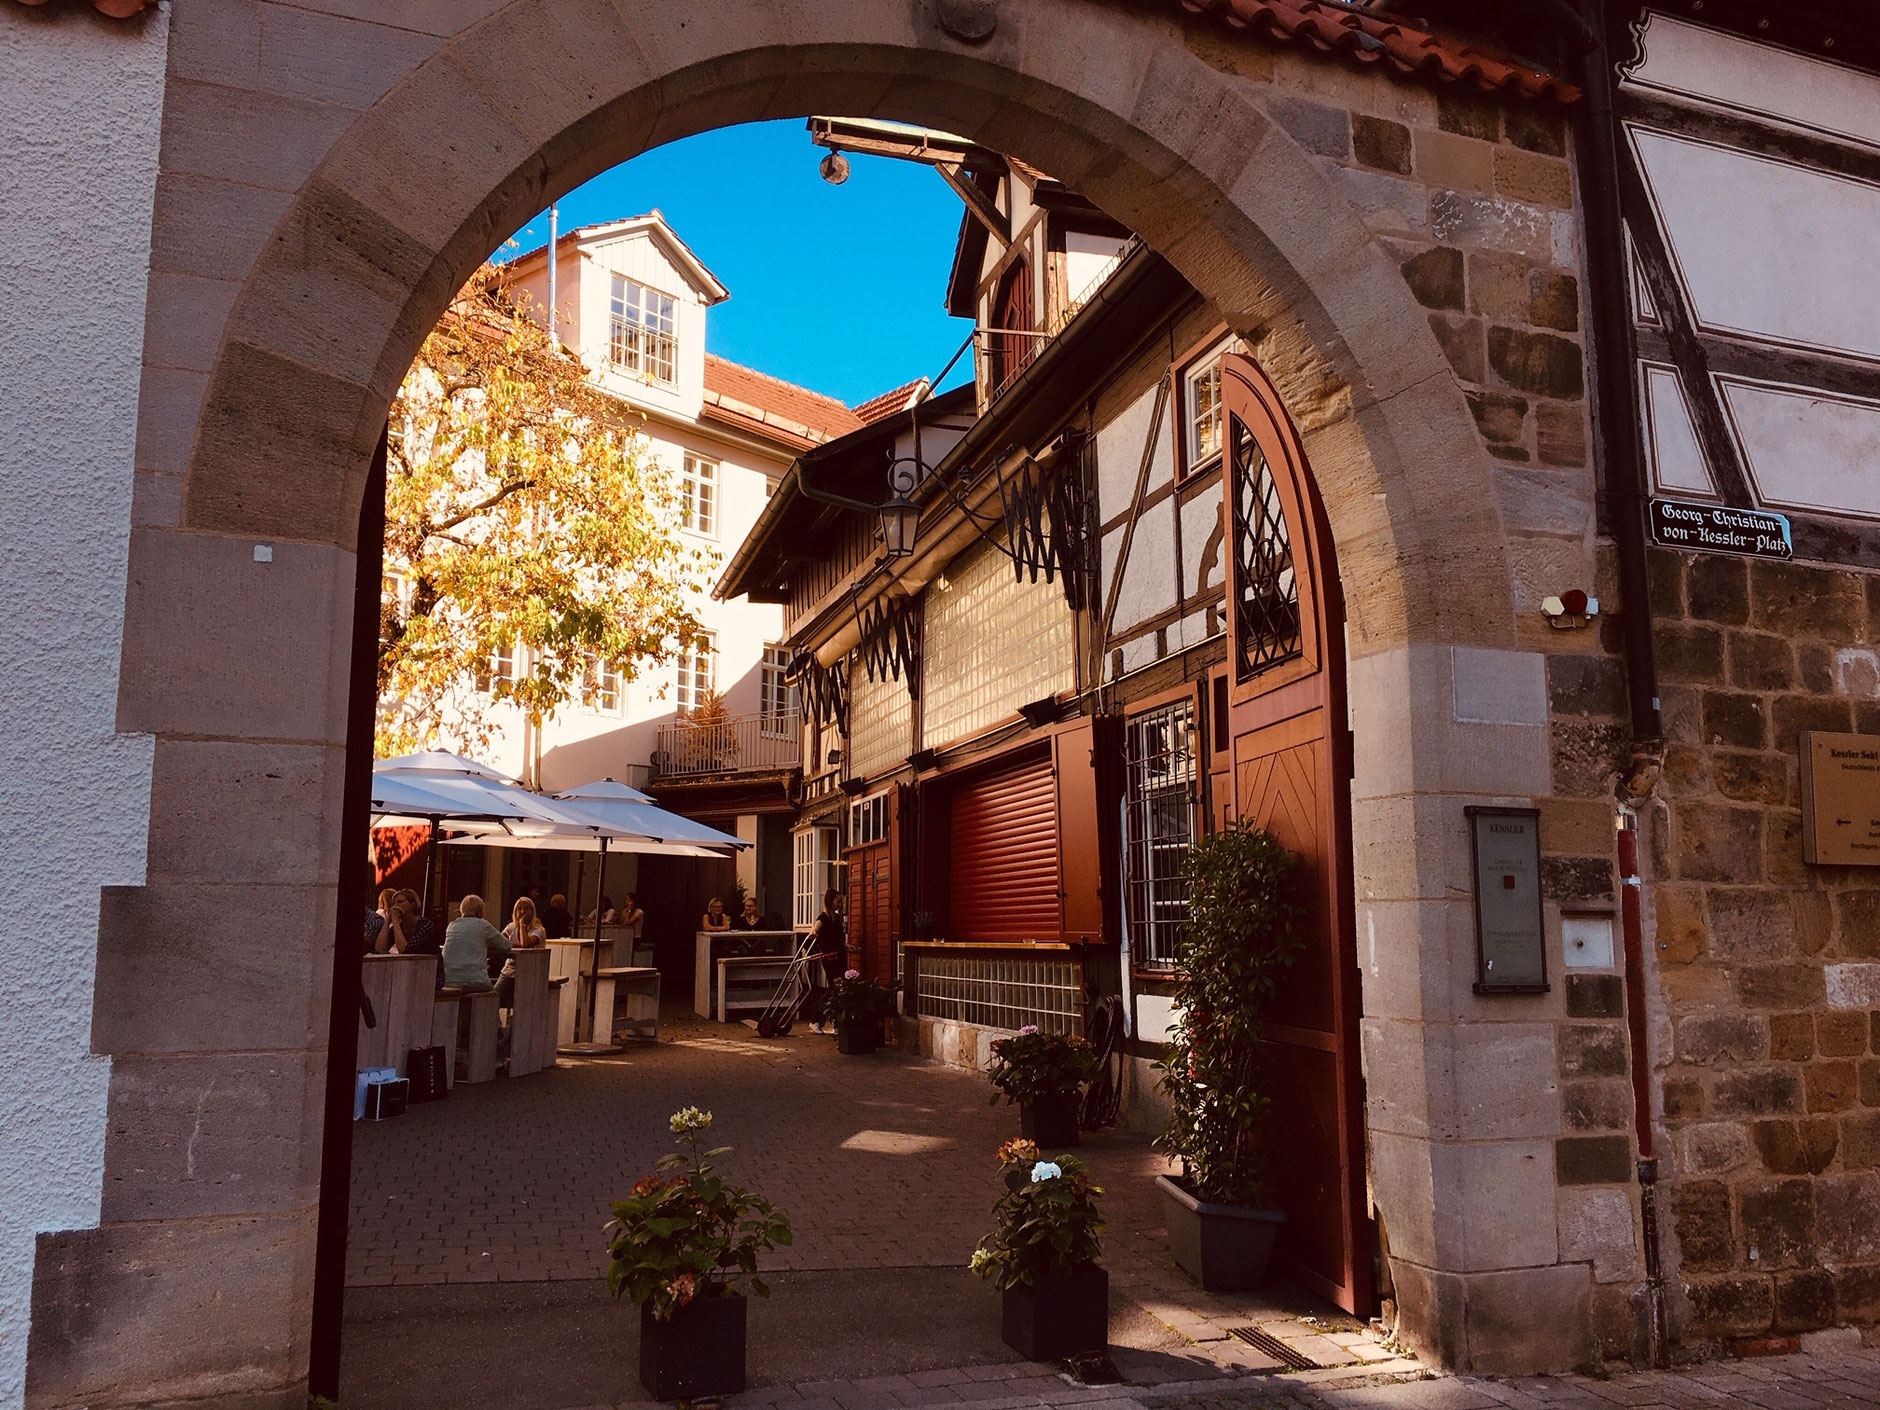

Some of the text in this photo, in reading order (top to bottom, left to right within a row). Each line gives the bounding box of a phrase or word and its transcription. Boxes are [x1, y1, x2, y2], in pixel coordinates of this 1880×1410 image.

[1661, 503, 1782, 532] Georg-Christian-
[1662, 525, 1786, 555] von-Kessler-Platz
[1830, 748, 1879, 760] Kessler Sekt
[1489, 823, 1525, 834] KESSLER
